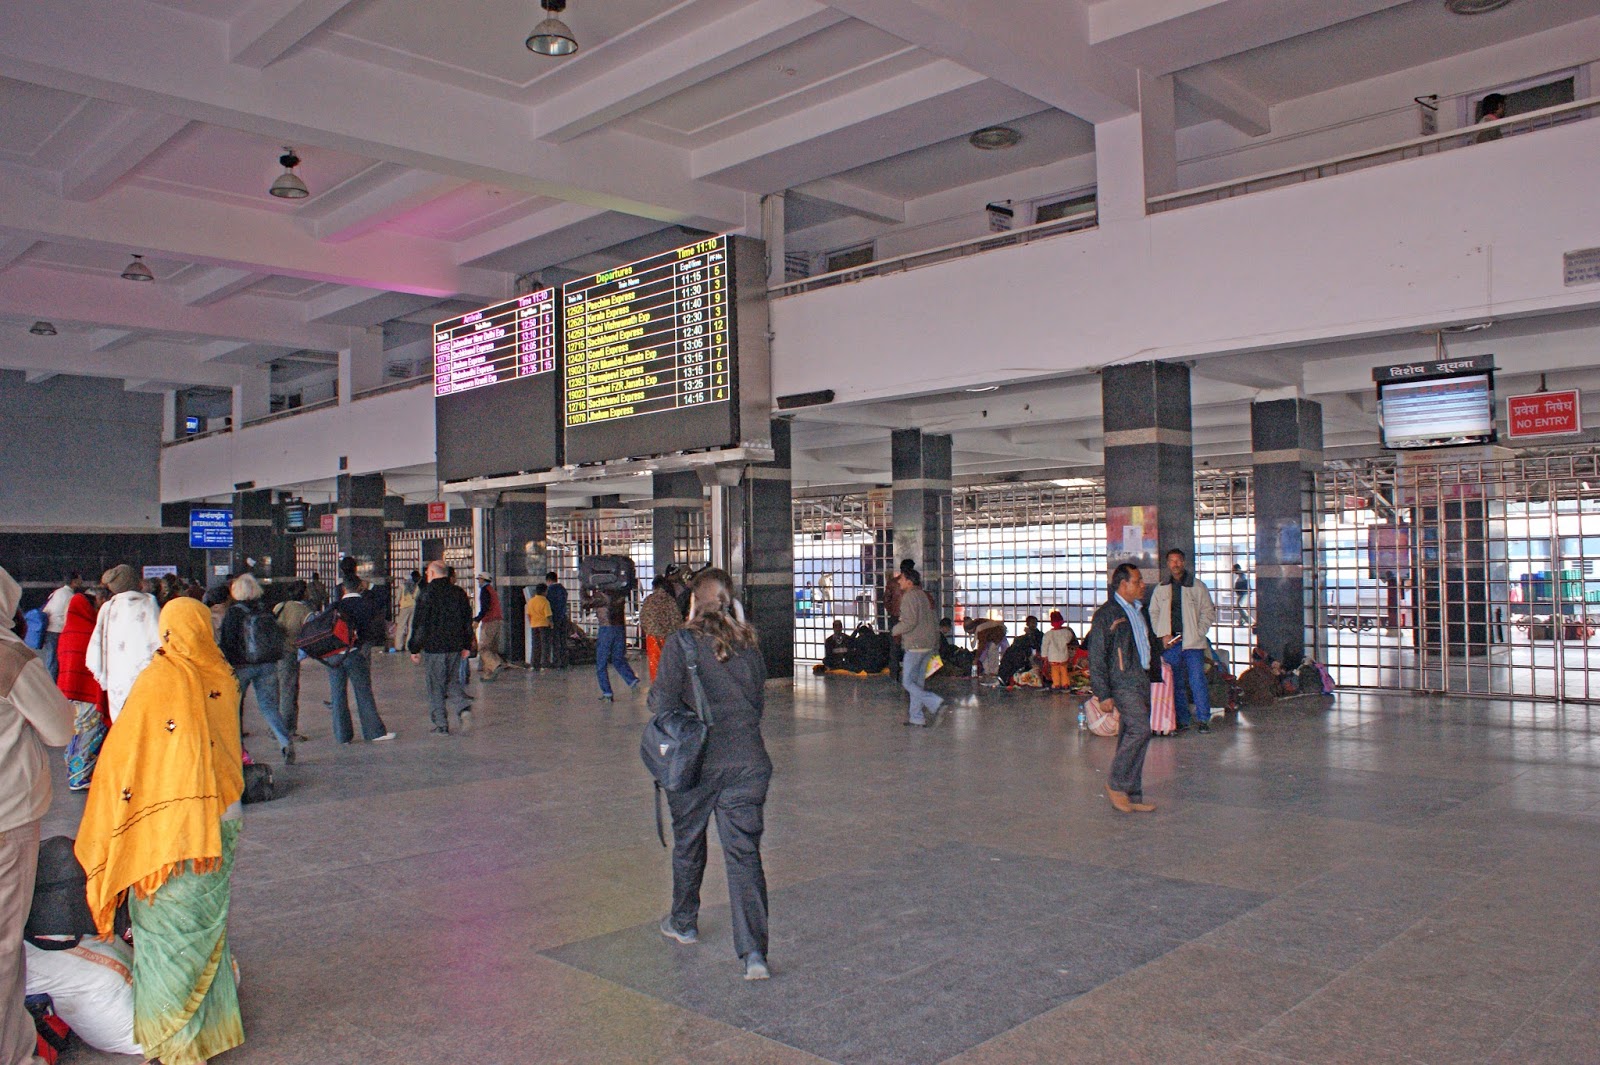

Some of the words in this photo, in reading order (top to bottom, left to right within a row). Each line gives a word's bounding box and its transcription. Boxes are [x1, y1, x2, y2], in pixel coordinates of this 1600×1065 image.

[596, 266, 633, 284] Departures
[677, 248, 695, 259] Time
[696, 239, 717, 254] 11:10
[588, 297, 610, 310] Paschim
[611, 292, 635, 304] Express
[681, 271, 701, 284] 11:15
[714, 265, 720, 276] 5
[588, 311, 605, 323] Kerala
[606, 306, 629, 318] Express
[682, 284, 701, 298] 11:30
[714, 279, 720, 289] 3
[463, 312, 483, 324] Arrivals
[519, 298, 531, 308] Time
[532, 291, 547, 303] 11:10
[588, 323, 603, 335] Kashi
[638, 312, 650, 322] Exp
[682, 297, 702, 311] 11:40
[714, 293, 721, 303] 9
[476, 342, 494, 354] Express
[521, 330, 536, 341] 13:10
[545, 325, 550, 334] 4
[496, 328, 505, 338] Exp
[521, 318, 536, 330] 12:50
[545, 314, 550, 323] 5
[568, 341, 585, 352] 12715
[619, 327, 643, 339] Express
[682, 312, 702, 324] 12:30
[715, 306, 721, 317] 3
[568, 352, 585, 364] 12420
[605, 344, 629, 356] Express
[682, 324, 703, 337] 12:40
[714, 319, 723, 330] 12
[468, 355, 486, 366] Express
[522, 341, 536, 352] 14:05
[545, 337, 550, 346] 4
[477, 364, 494, 375] Express
[522, 352, 537, 364] 16:00
[545, 348, 550, 358] 8
[588, 361, 599, 371] FZR
[600, 356, 623, 369] Mumbai
[624, 352, 644, 364] Janata
[645, 350, 657, 360] Exp
[683, 338, 703, 351] 13:05
[715, 334, 722, 344] 9
[620, 366, 644, 378] Express
[683, 351, 703, 364] 13:15
[715, 347, 722, 357] 7
[488, 374, 497, 384] Exp
[522, 364, 537, 375] 21:35
[544, 360, 552, 369] 15
[611, 381, 624, 392] FZR
[624, 378, 644, 389] Janata
[645, 376, 657, 385] Exp
[683, 365, 703, 377] 13:15
[716, 361, 722, 372] 6
[1390, 366, 1425, 377] विशेष
[1436, 360, 1474, 374] सूचना
[620, 391, 645, 403] Express
[683, 378, 704, 391] 13:25
[716, 374, 722, 385] 4
[569, 413, 586, 424] 11078
[610, 406, 634, 418] Express
[684, 392, 704, 404] 14:15
[717, 389, 723, 399] 4
[1513, 402, 1539, 417] प्रवेश
[1543, 398, 1573, 414] निषेध
[1516, 419, 1531, 429] NO
[1535, 415, 1569, 428] ENTRY
